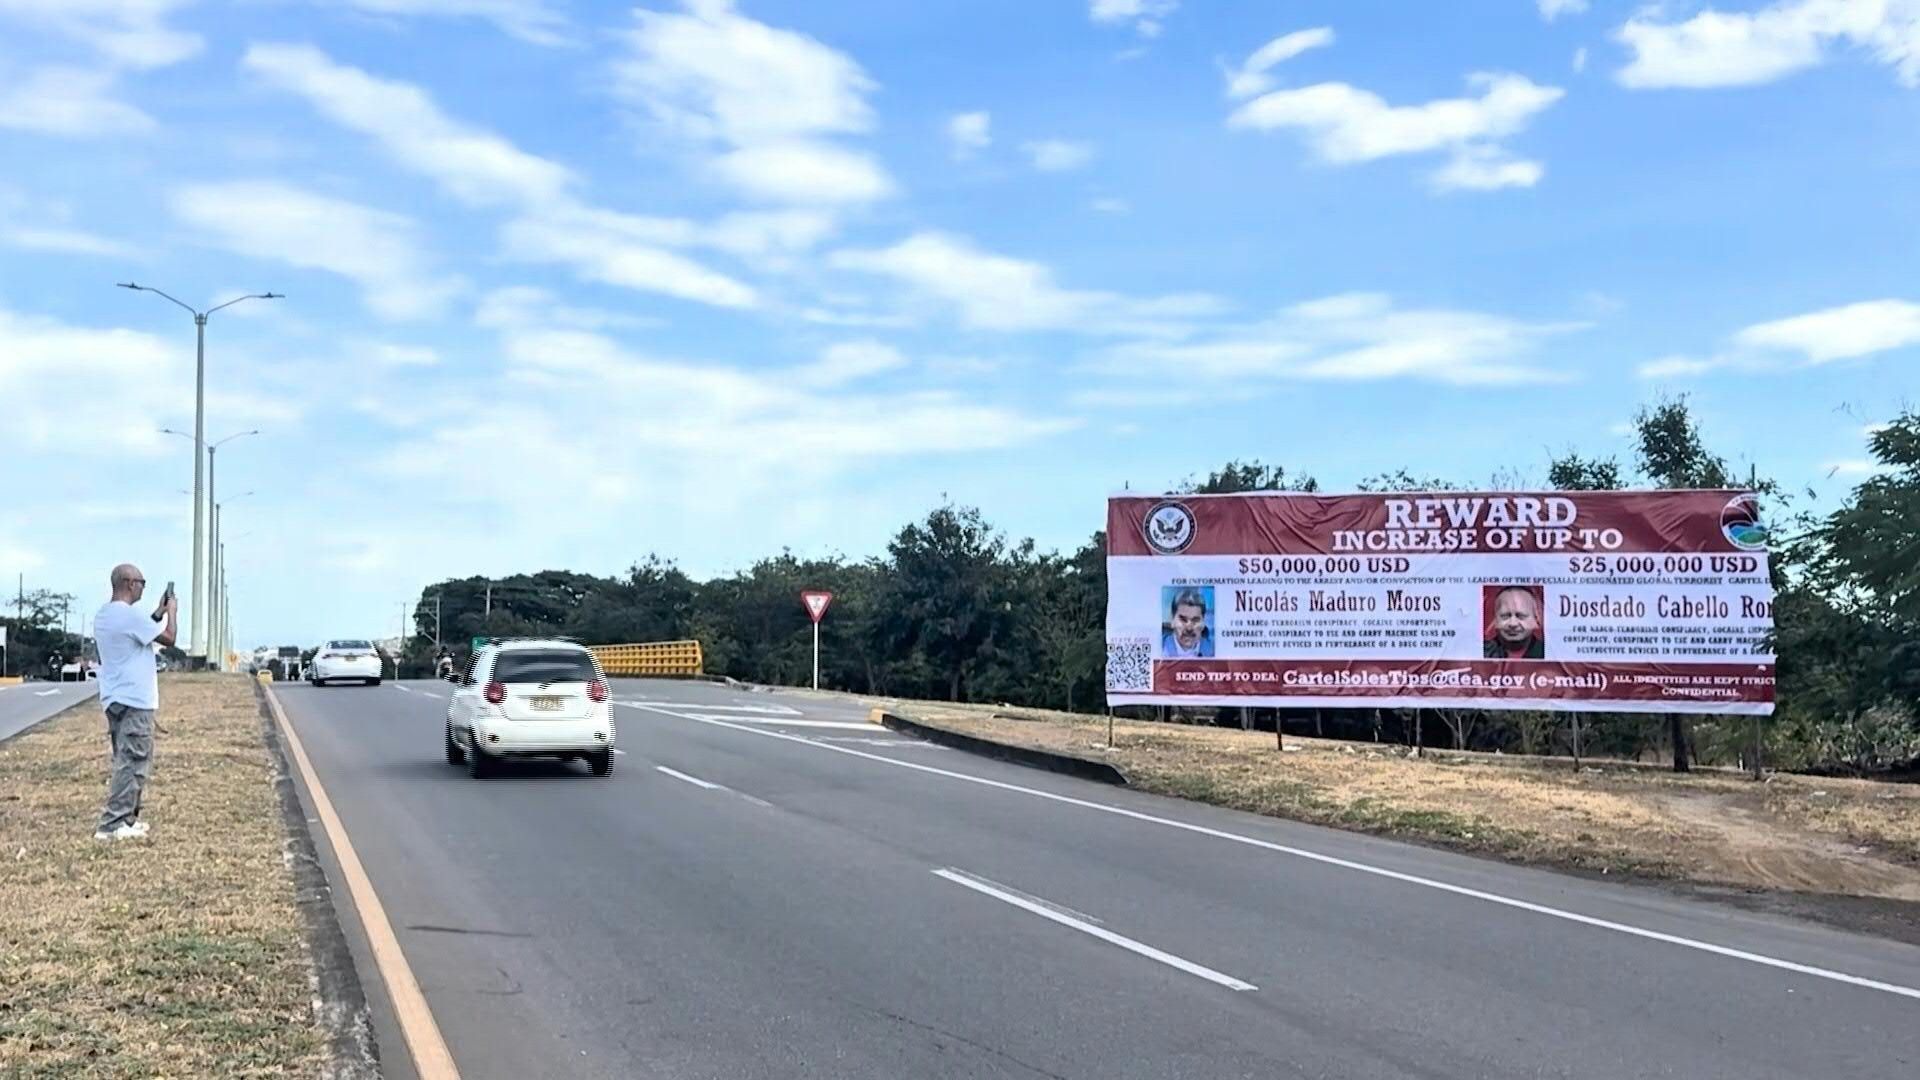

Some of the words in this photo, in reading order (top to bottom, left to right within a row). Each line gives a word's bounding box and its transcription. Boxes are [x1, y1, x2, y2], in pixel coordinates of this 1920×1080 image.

[1384, 497, 1577, 528] REWARD
[1332, 529, 1478, 550] INCREASE
[1485, 529, 1528, 550] OF
[1534, 529, 1572, 549] UP
[1579, 528, 1624, 549] TO
[1239, 558, 1361, 576] $50,000,000
[1367, 557, 1410, 573] USD
[1569, 556, 1703, 576] $25,000,000
[1710, 556, 1758, 573] USD
[1235, 590, 1298, 612] Nicolás
[1309, 590, 1376, 612] Maduro
[1386, 590, 1441, 612] Moros
[1560, 595, 1645, 618] Diosdado
[1657, 595, 1729, 618] Cabello
[1175, 672, 1205, 681] SEND
[1207, 672, 1231, 681] TIPS
[1233, 672, 1249, 681] TO
[1252, 672, 1278, 681] DEA:
[1282, 670, 1525, 688] CartelSolesTips@dea.gov
[1529, 672, 1607, 691] (e-mail)
[1612, 675, 1632, 683] ALL
[1634, 675, 1690, 684] IDENTITIES
[1692, 675, 1712, 684] ARE
[1714, 676, 1739, 685] KEPT
